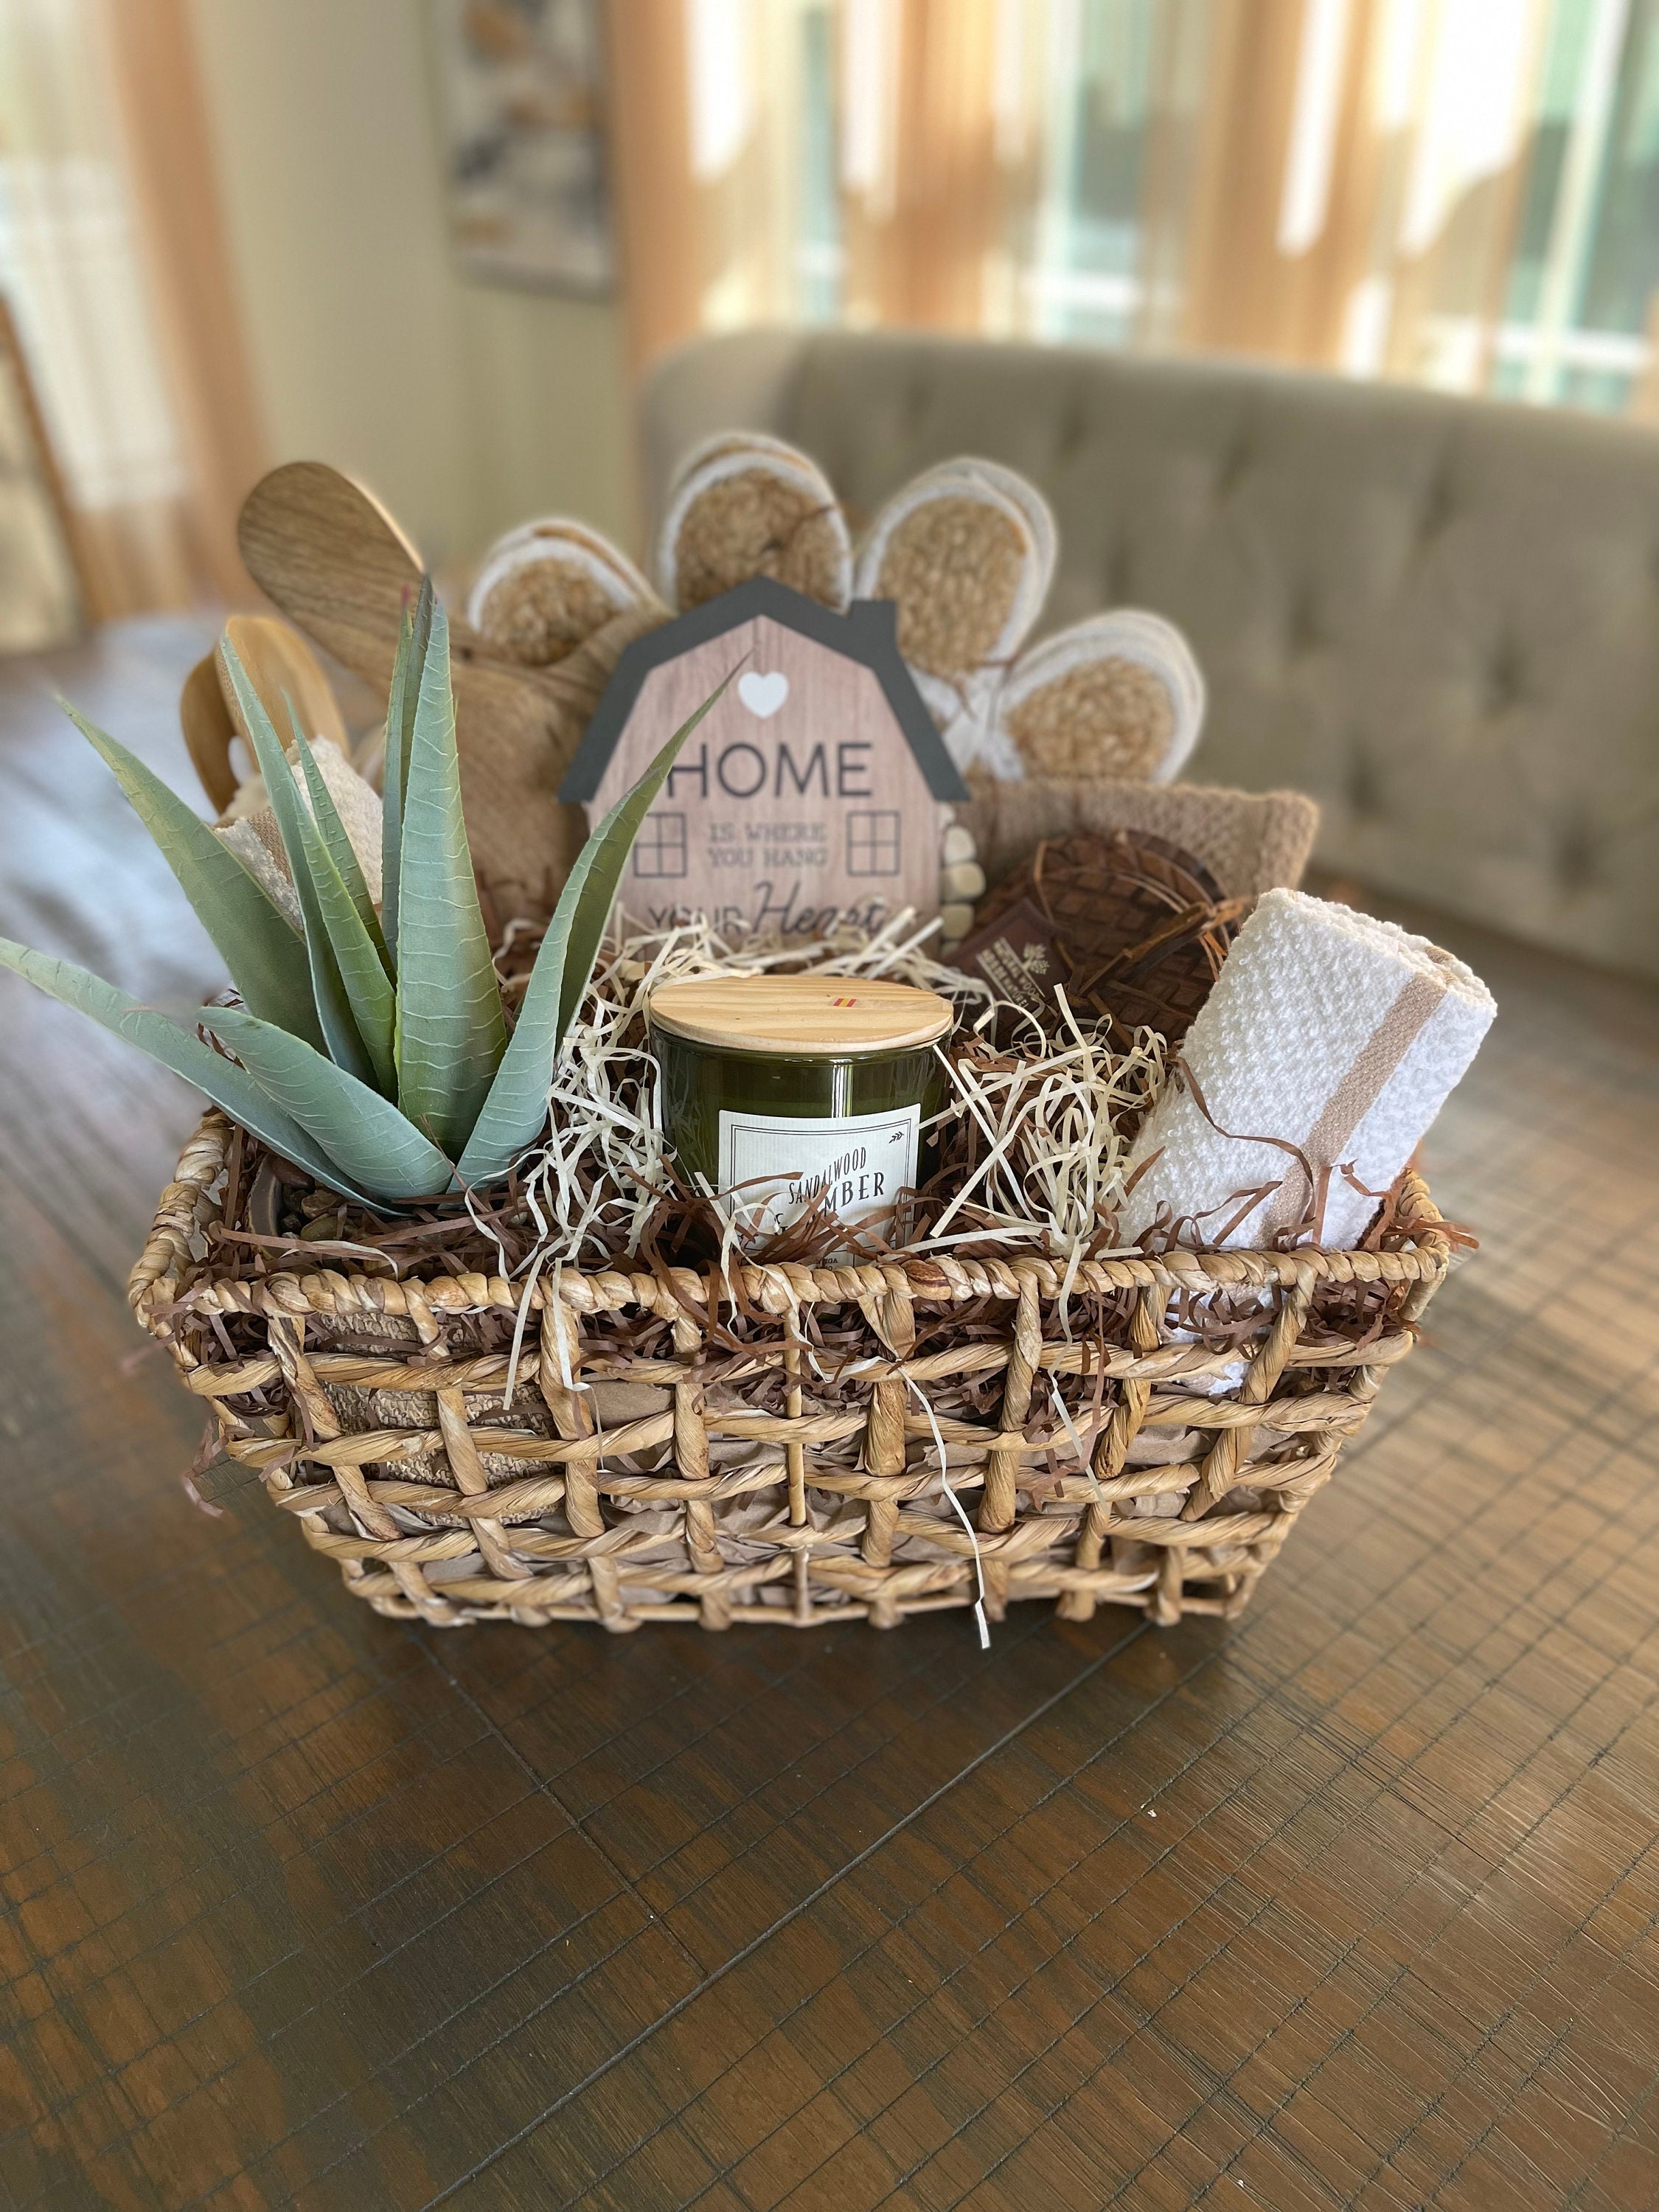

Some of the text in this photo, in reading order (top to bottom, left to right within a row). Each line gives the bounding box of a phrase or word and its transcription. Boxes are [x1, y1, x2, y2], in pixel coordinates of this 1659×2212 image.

[667, 742, 872, 799] HOME
[707, 847, 827, 867] YOU HANG
[709, 822, 827, 843] IS WHERE
[788, 1147, 866, 1204] SANDALWOOD
[811, 1172, 885, 1221] MBER
